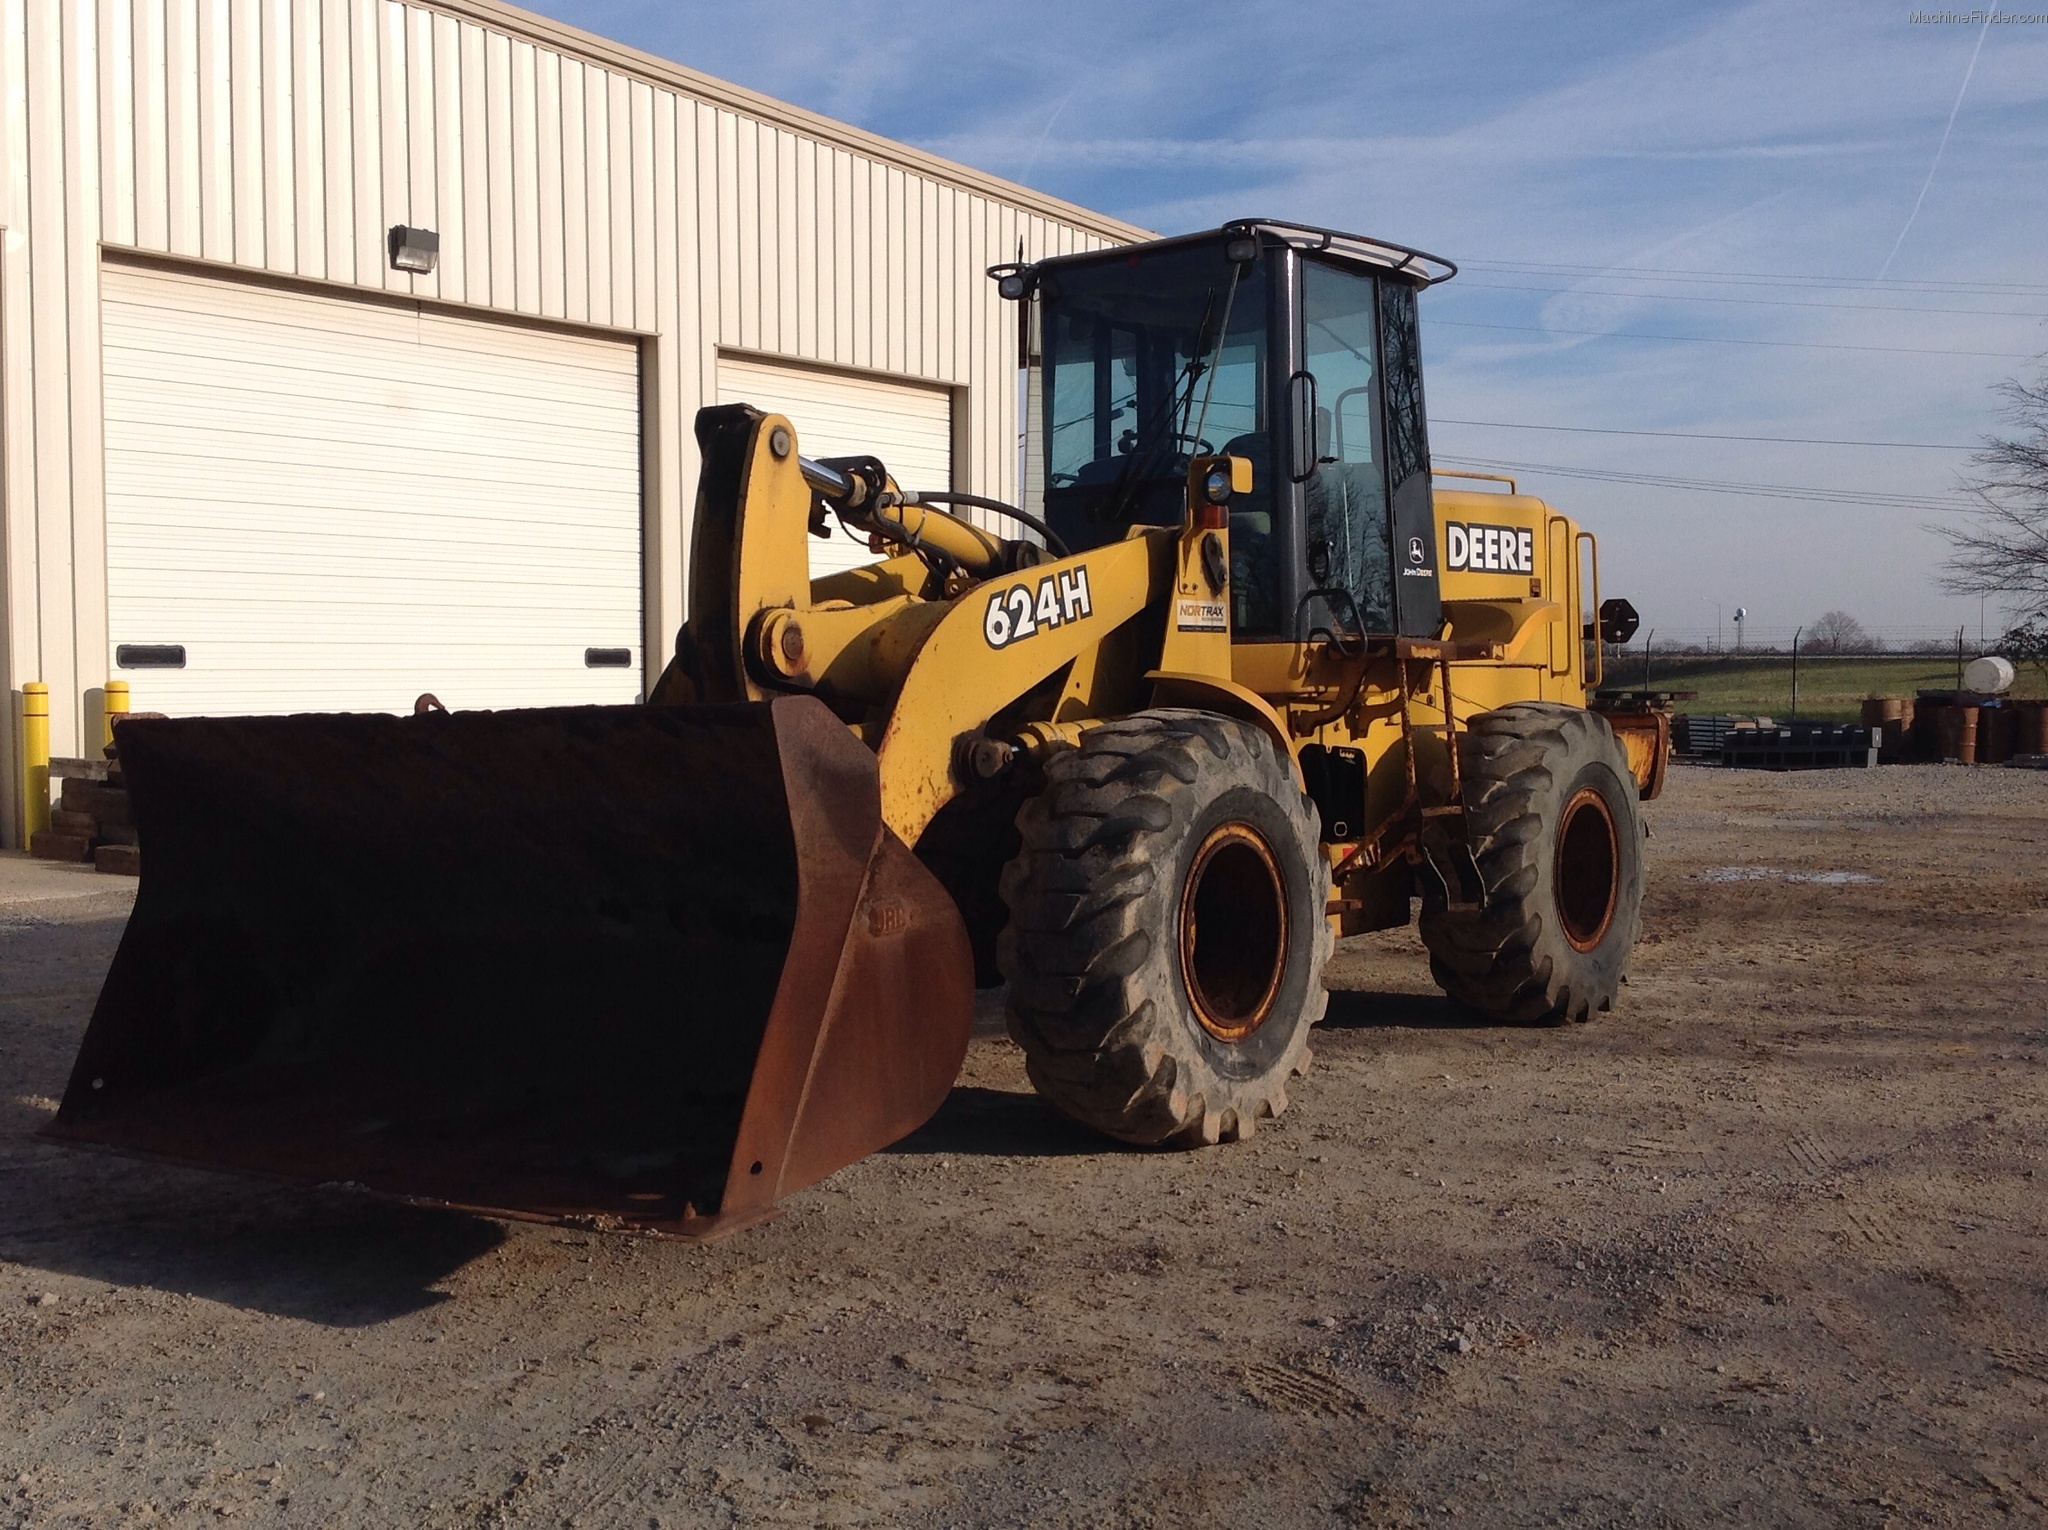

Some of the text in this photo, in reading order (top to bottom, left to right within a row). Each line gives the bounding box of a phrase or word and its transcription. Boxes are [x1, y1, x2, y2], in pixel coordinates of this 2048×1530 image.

[1447, 523, 1533, 574] DEERE
[985, 566, 1091, 649] 624H
[1180, 605, 1224, 617] NORTRAX
